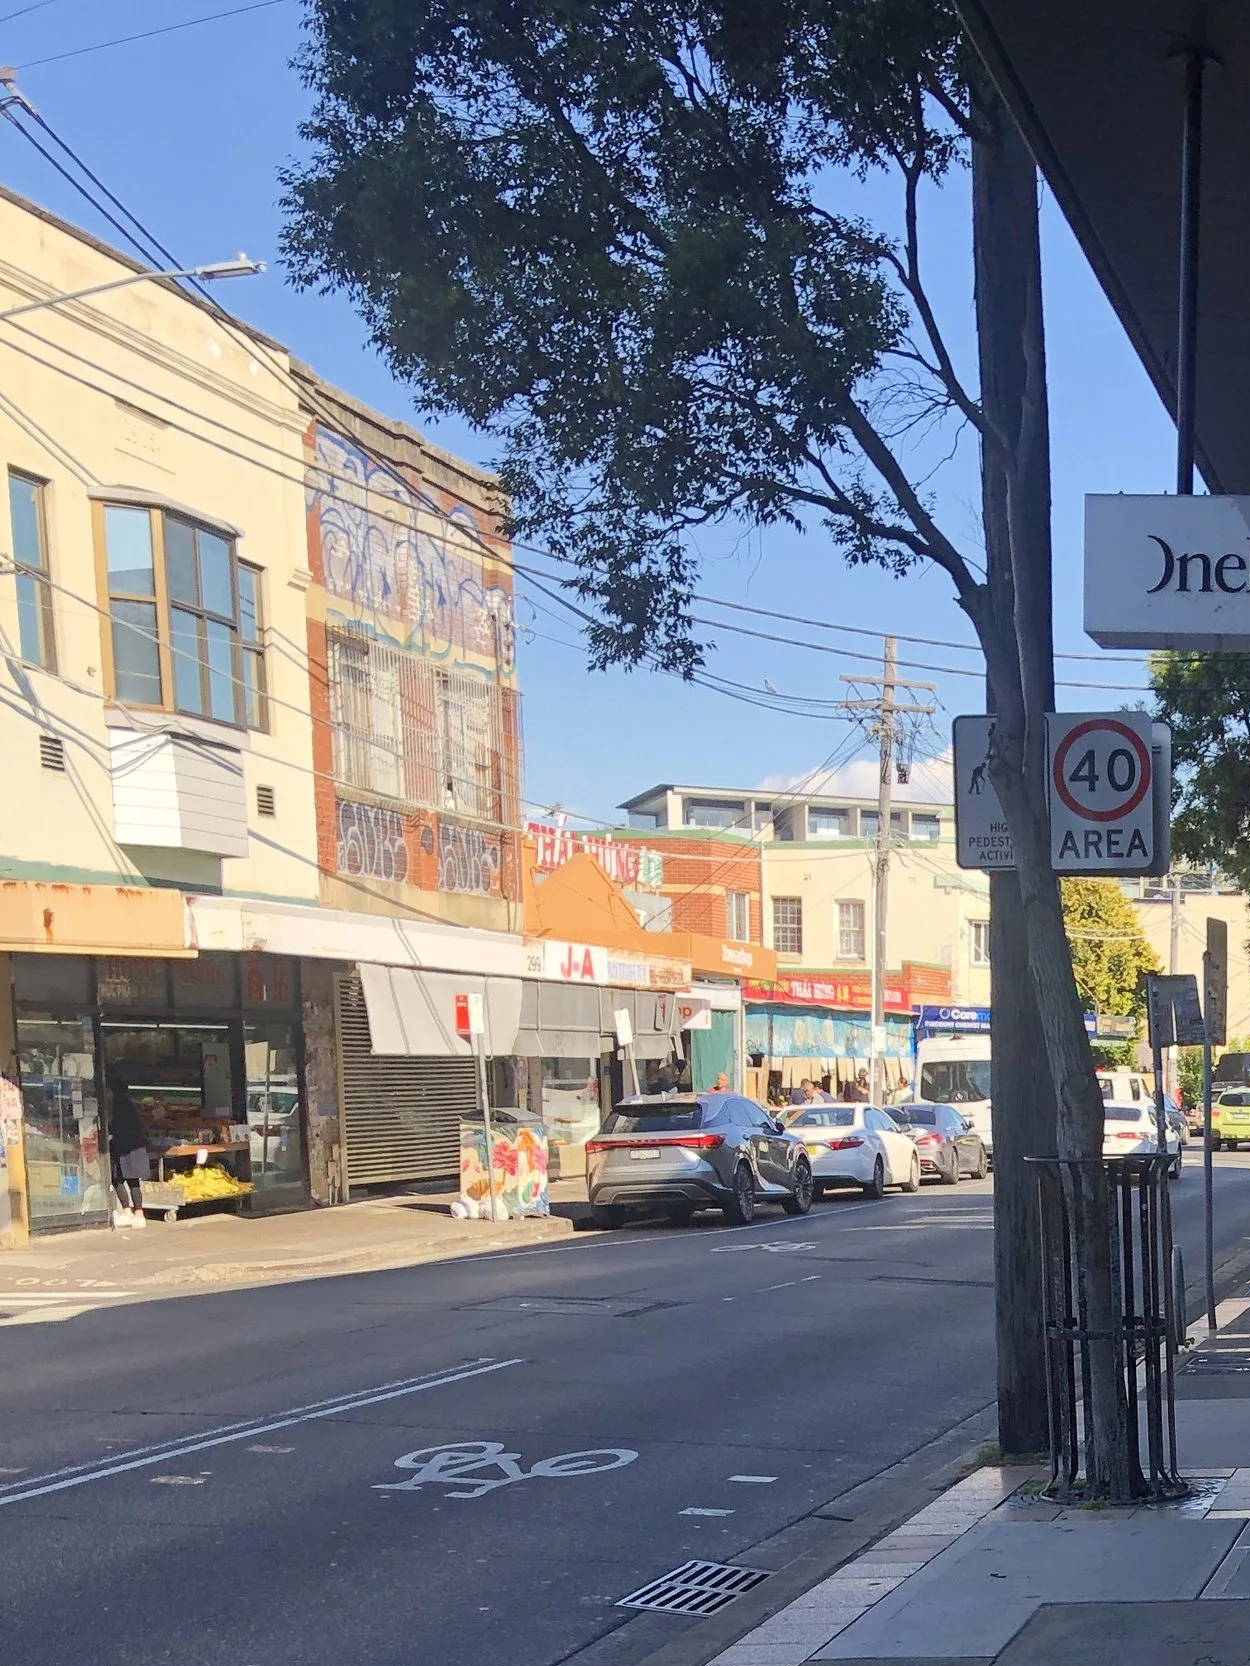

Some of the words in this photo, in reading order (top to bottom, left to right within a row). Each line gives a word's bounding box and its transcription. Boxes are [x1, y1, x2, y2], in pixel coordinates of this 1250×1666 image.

[1069, 748, 1136, 792] 40
[990, 822, 1008, 832] HIG
[968, 836, 1013, 848] PEDEST
[1058, 829, 1149, 859] AREA
[979, 851, 1013, 861] ACTIVI
[527, 955, 541, 973] 299
